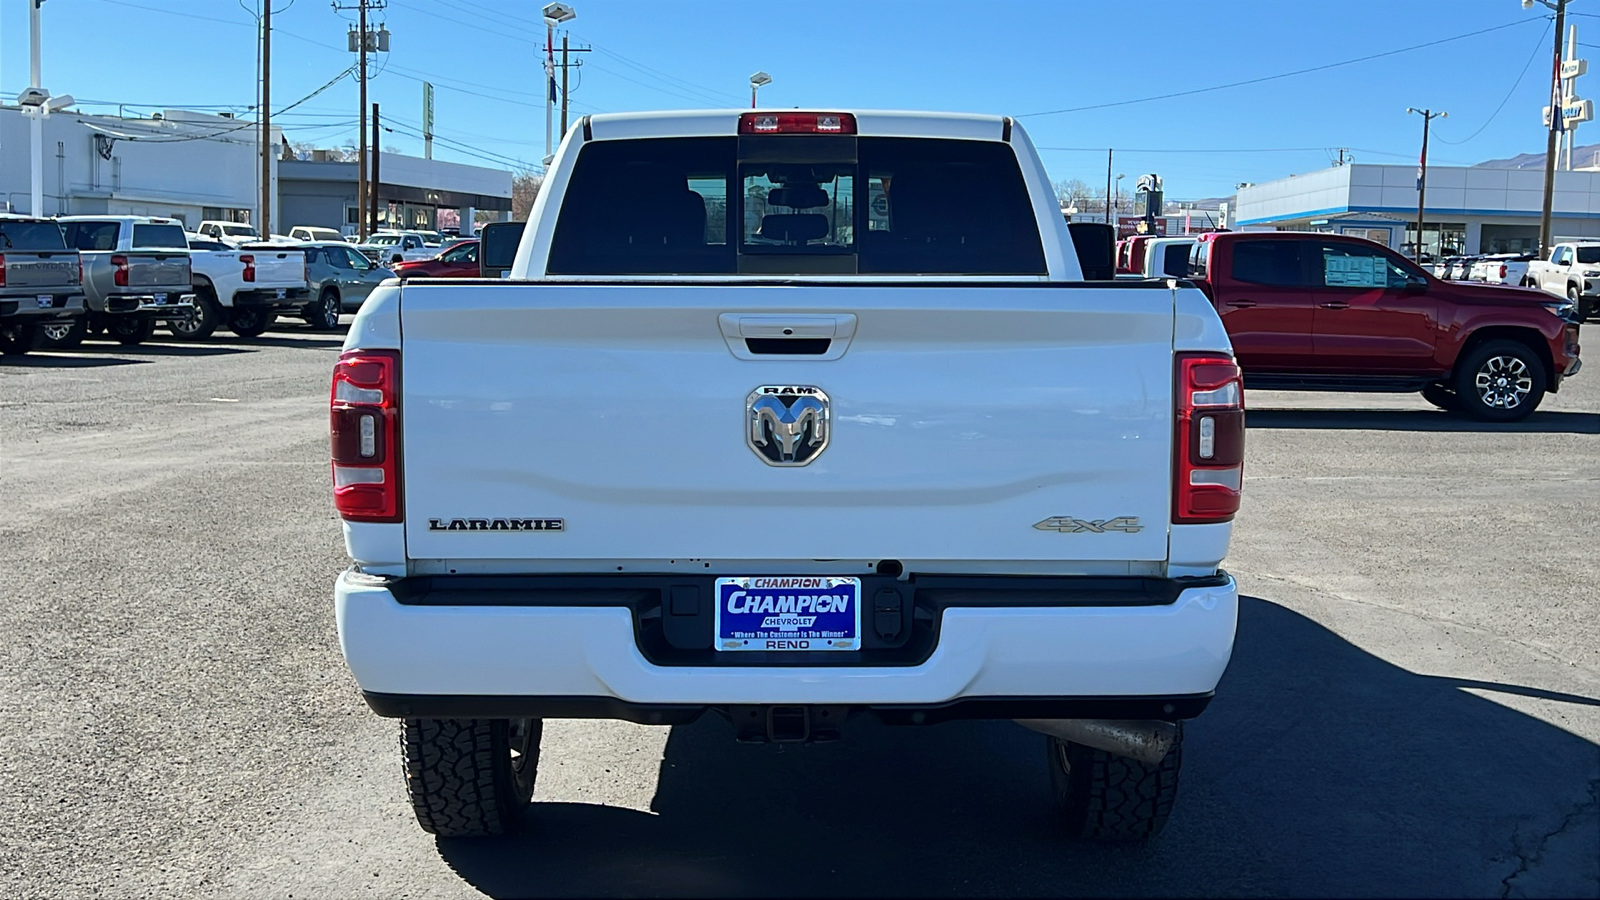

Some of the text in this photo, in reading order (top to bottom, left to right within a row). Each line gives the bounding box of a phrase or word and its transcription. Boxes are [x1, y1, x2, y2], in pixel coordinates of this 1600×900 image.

[428, 518, 564, 531] LARAMIE
[754, 578, 822, 588] CHAMPION
[727, 591, 849, 614] CHAMPION
[764, 618, 813, 626] CHEVROLET
[757, 631, 768, 639] The
[769, 631, 800, 639] Customer
[801, 631, 808, 639] Is
[809, 631, 820, 639] The
[765, 640, 810, 649] RENO
